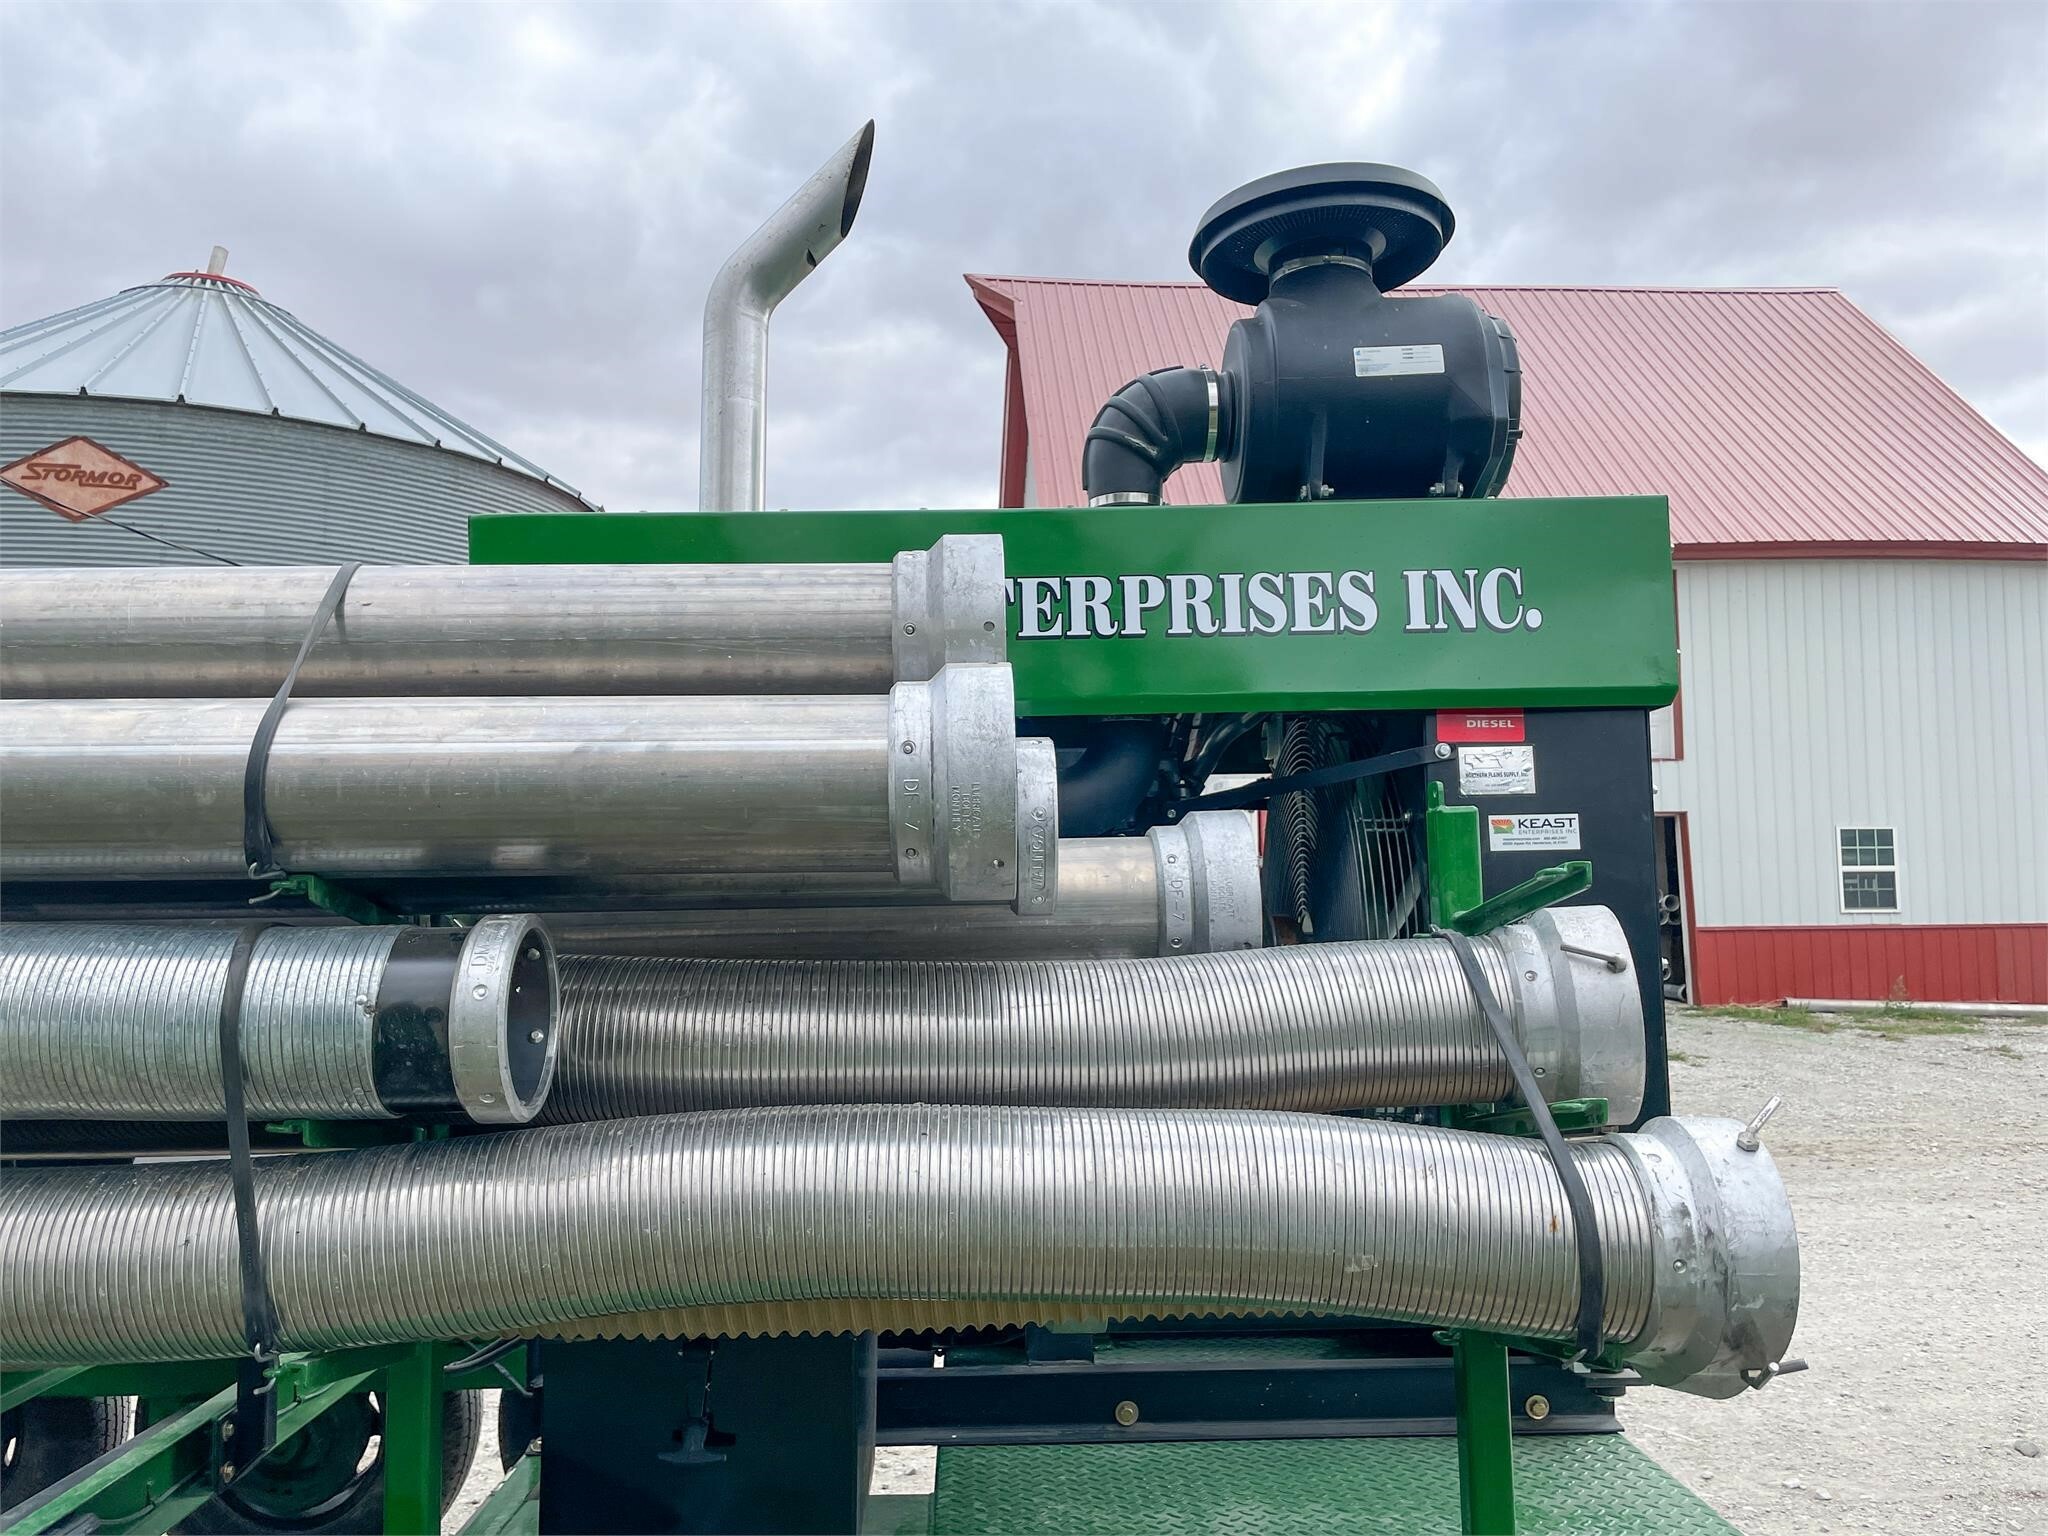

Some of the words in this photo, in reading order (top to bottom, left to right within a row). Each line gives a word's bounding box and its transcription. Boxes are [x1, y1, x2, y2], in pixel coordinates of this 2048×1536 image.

[20, 463, 142, 490] STORMOR
[1403, 567, 1543, 632] INC.
[1466, 719, 1516, 728] DIESEL
[1518, 817, 1576, 829] KEAST
[1168, 879, 1185, 922] DF-7
